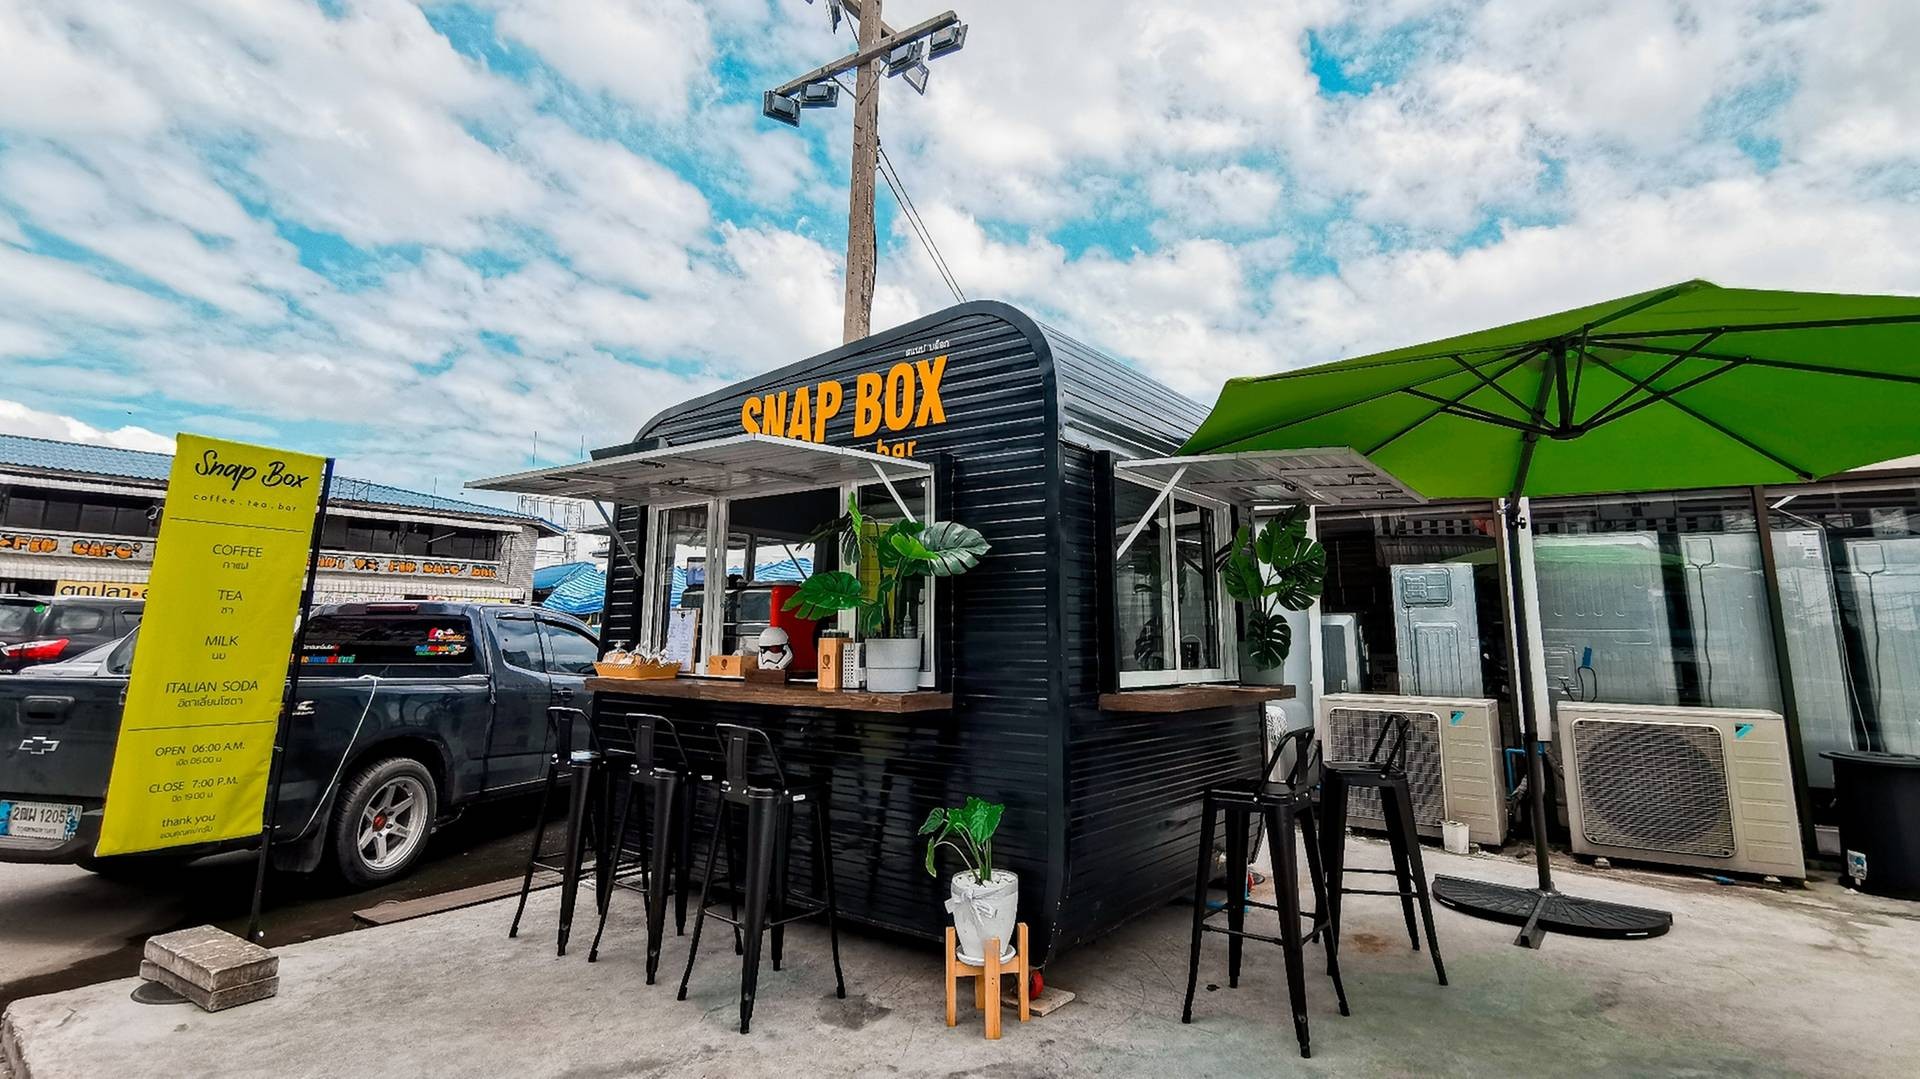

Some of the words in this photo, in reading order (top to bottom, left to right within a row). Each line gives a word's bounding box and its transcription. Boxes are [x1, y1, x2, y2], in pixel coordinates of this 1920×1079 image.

[741, 379, 844, 444] SNAP
[853, 354, 949, 439] BOX
[876, 438, 918, 459] bar
[195, 449, 257, 491] Snap
[261, 460, 309, 488] Box
[212, 543, 263, 558] COFFEE
[217, 589, 243, 601] TEA
[205, 635, 239, 647] MILK
[165, 681, 218, 694] ITALIAN
[221, 680, 259, 692] SODA
[155, 746, 186, 757] OPEN
[192, 743, 221, 754] 06:00
[148, 781, 185, 793] CLOSE
[192, 778, 214, 788] 7:00
[40, 808, 67, 824] 1205
[162, 815, 192, 828] thank
[194, 814, 216, 825] you
